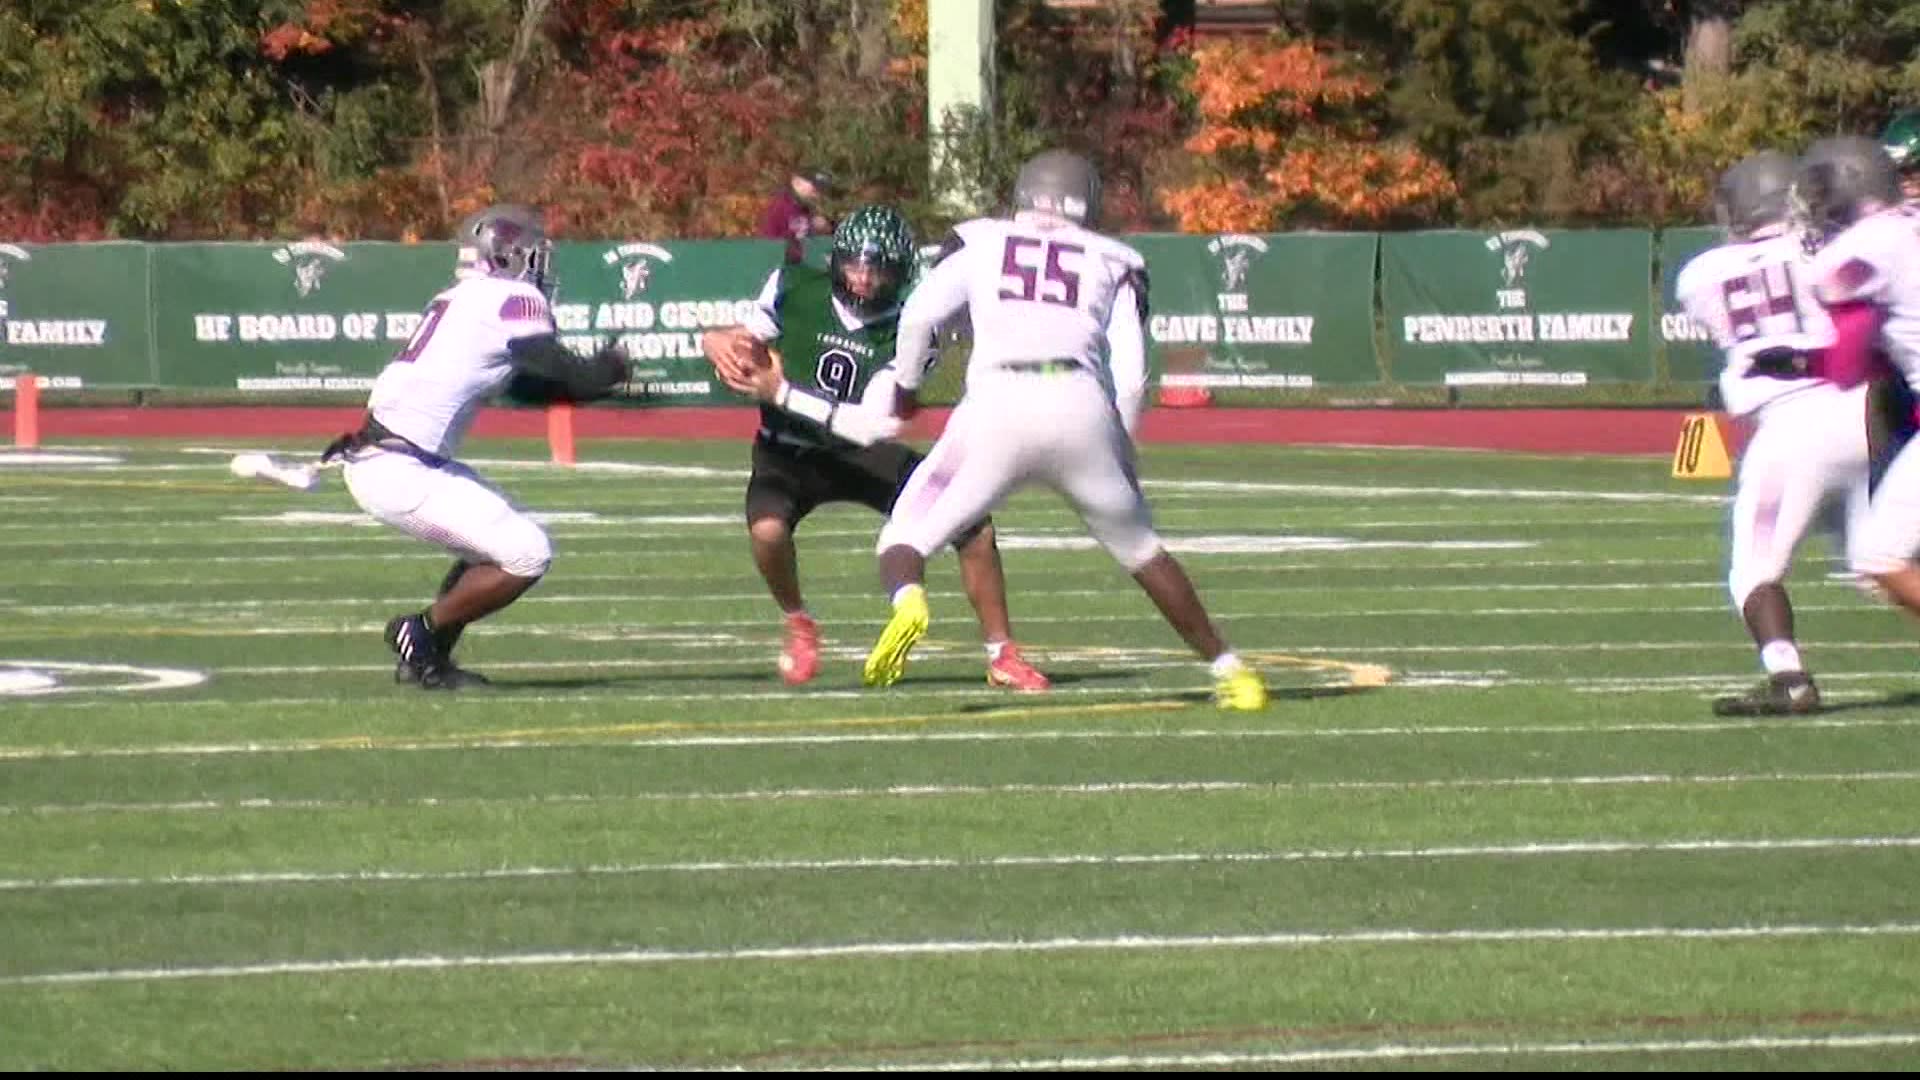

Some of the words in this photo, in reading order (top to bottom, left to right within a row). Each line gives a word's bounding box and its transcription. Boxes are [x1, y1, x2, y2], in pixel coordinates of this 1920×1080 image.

[998, 236, 1085, 308] 55
[1496, 289, 1525, 308] THE
[238, 313, 337, 340] BOARD
[342, 313, 379, 340] OF
[596, 302, 655, 329] AND
[1150, 314, 1217, 342] CAVE
[1222, 316, 1314, 343] FAMILY
[1537, 313, 1633, 340] FAMILY
[7, 320, 107, 344] FAMILY
[816, 349, 858, 402] 9
[1677, 416, 1704, 474] 10
